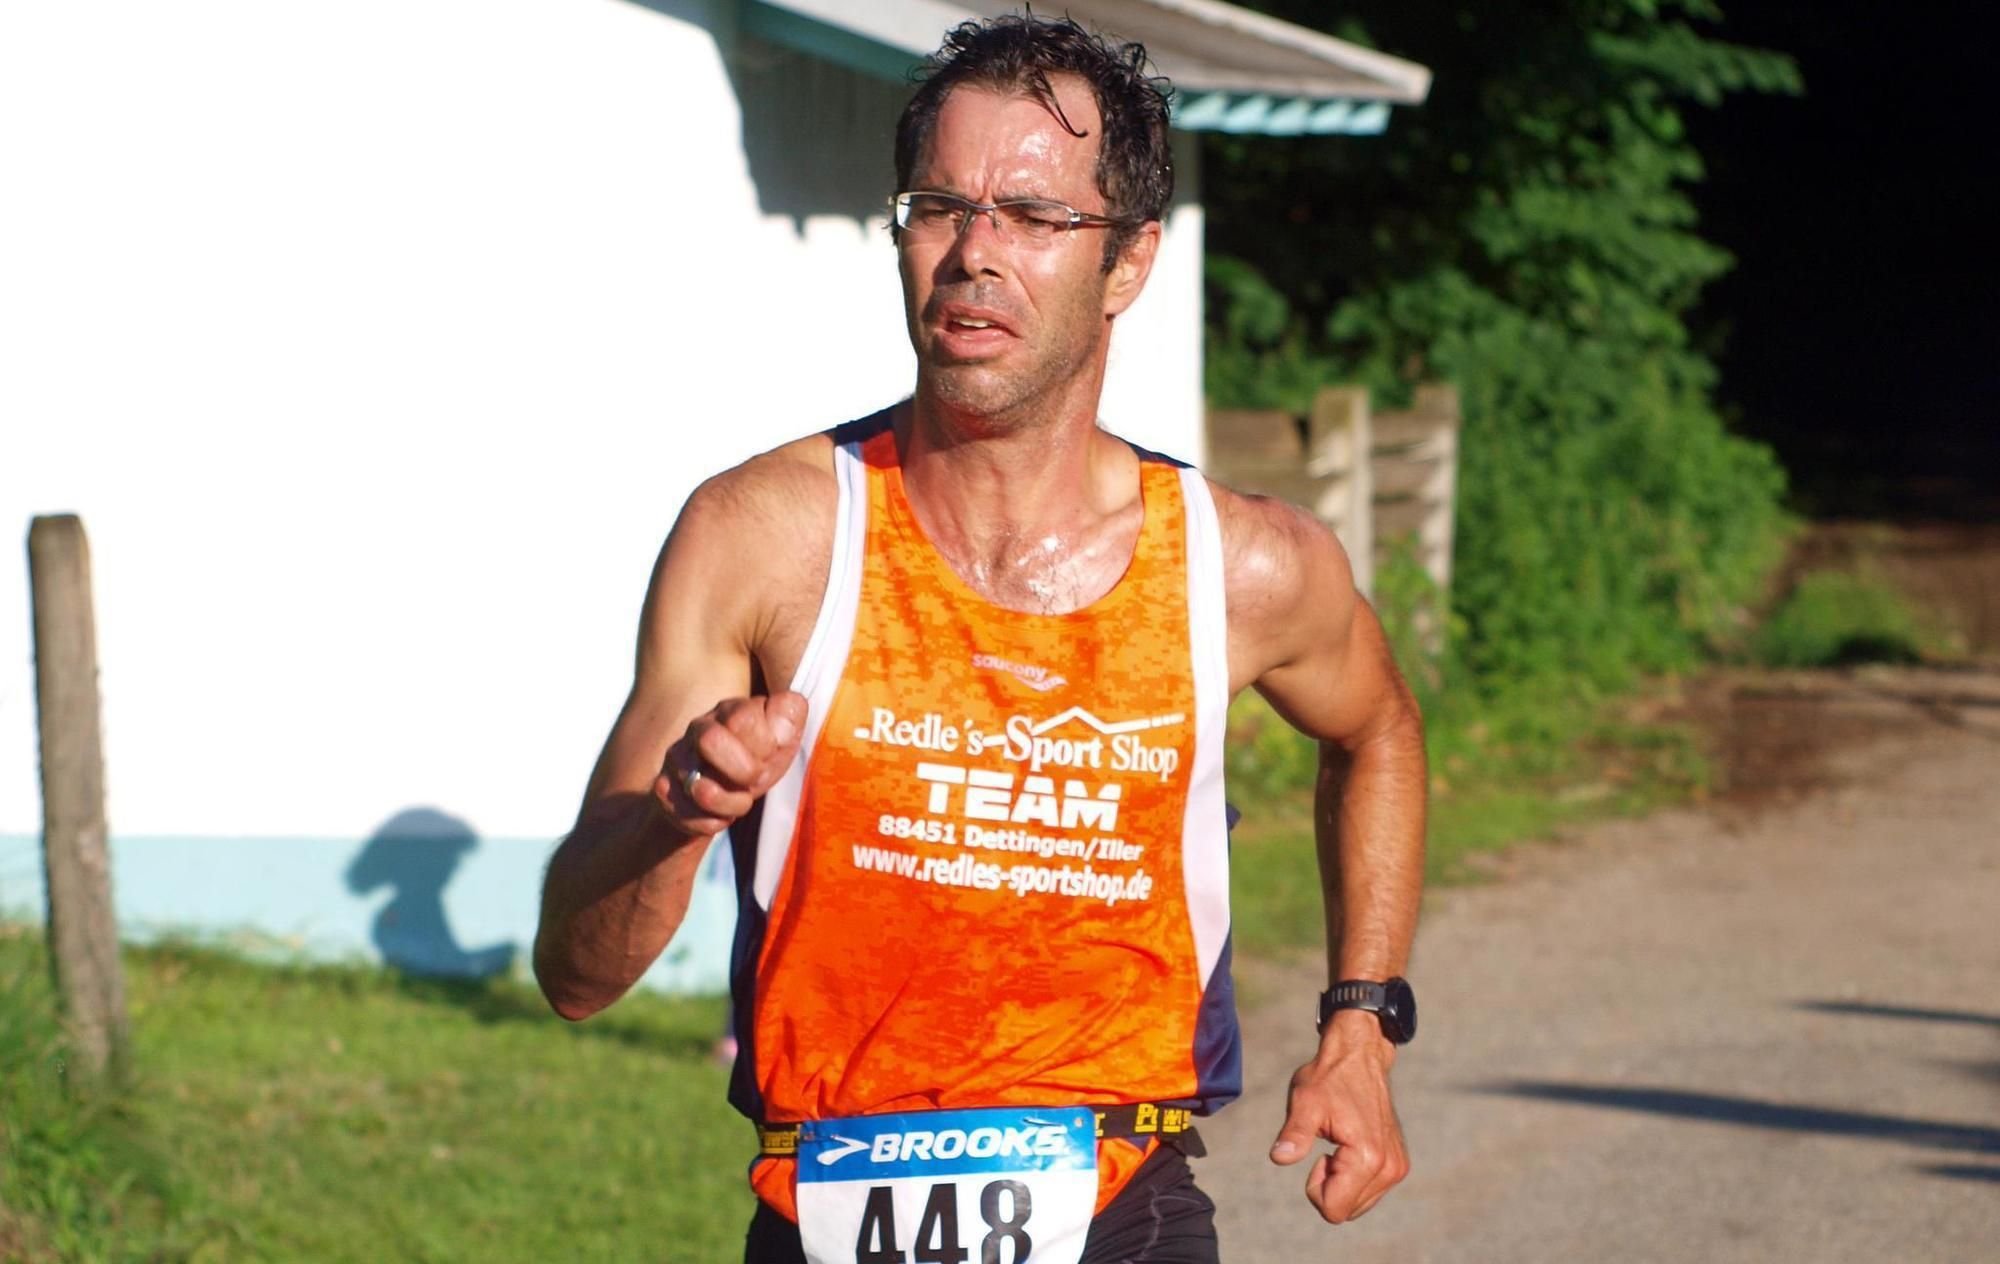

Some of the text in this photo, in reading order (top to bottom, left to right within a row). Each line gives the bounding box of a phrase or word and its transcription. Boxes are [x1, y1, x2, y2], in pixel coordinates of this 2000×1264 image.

[971, 653, 1048, 682] saucony
[1003, 715, 1104, 772] Sport
[1110, 734, 1179, 783] Shop
[916, 762, 1122, 832] TEAM
[878, 814, 1145, 862] 88451 Dettingen/Iller
[852, 844, 1153, 907] www.redles-sportshop.de
[870, 1125, 1069, 1163] BROOKS
[856, 1179, 1033, 1264] 448
